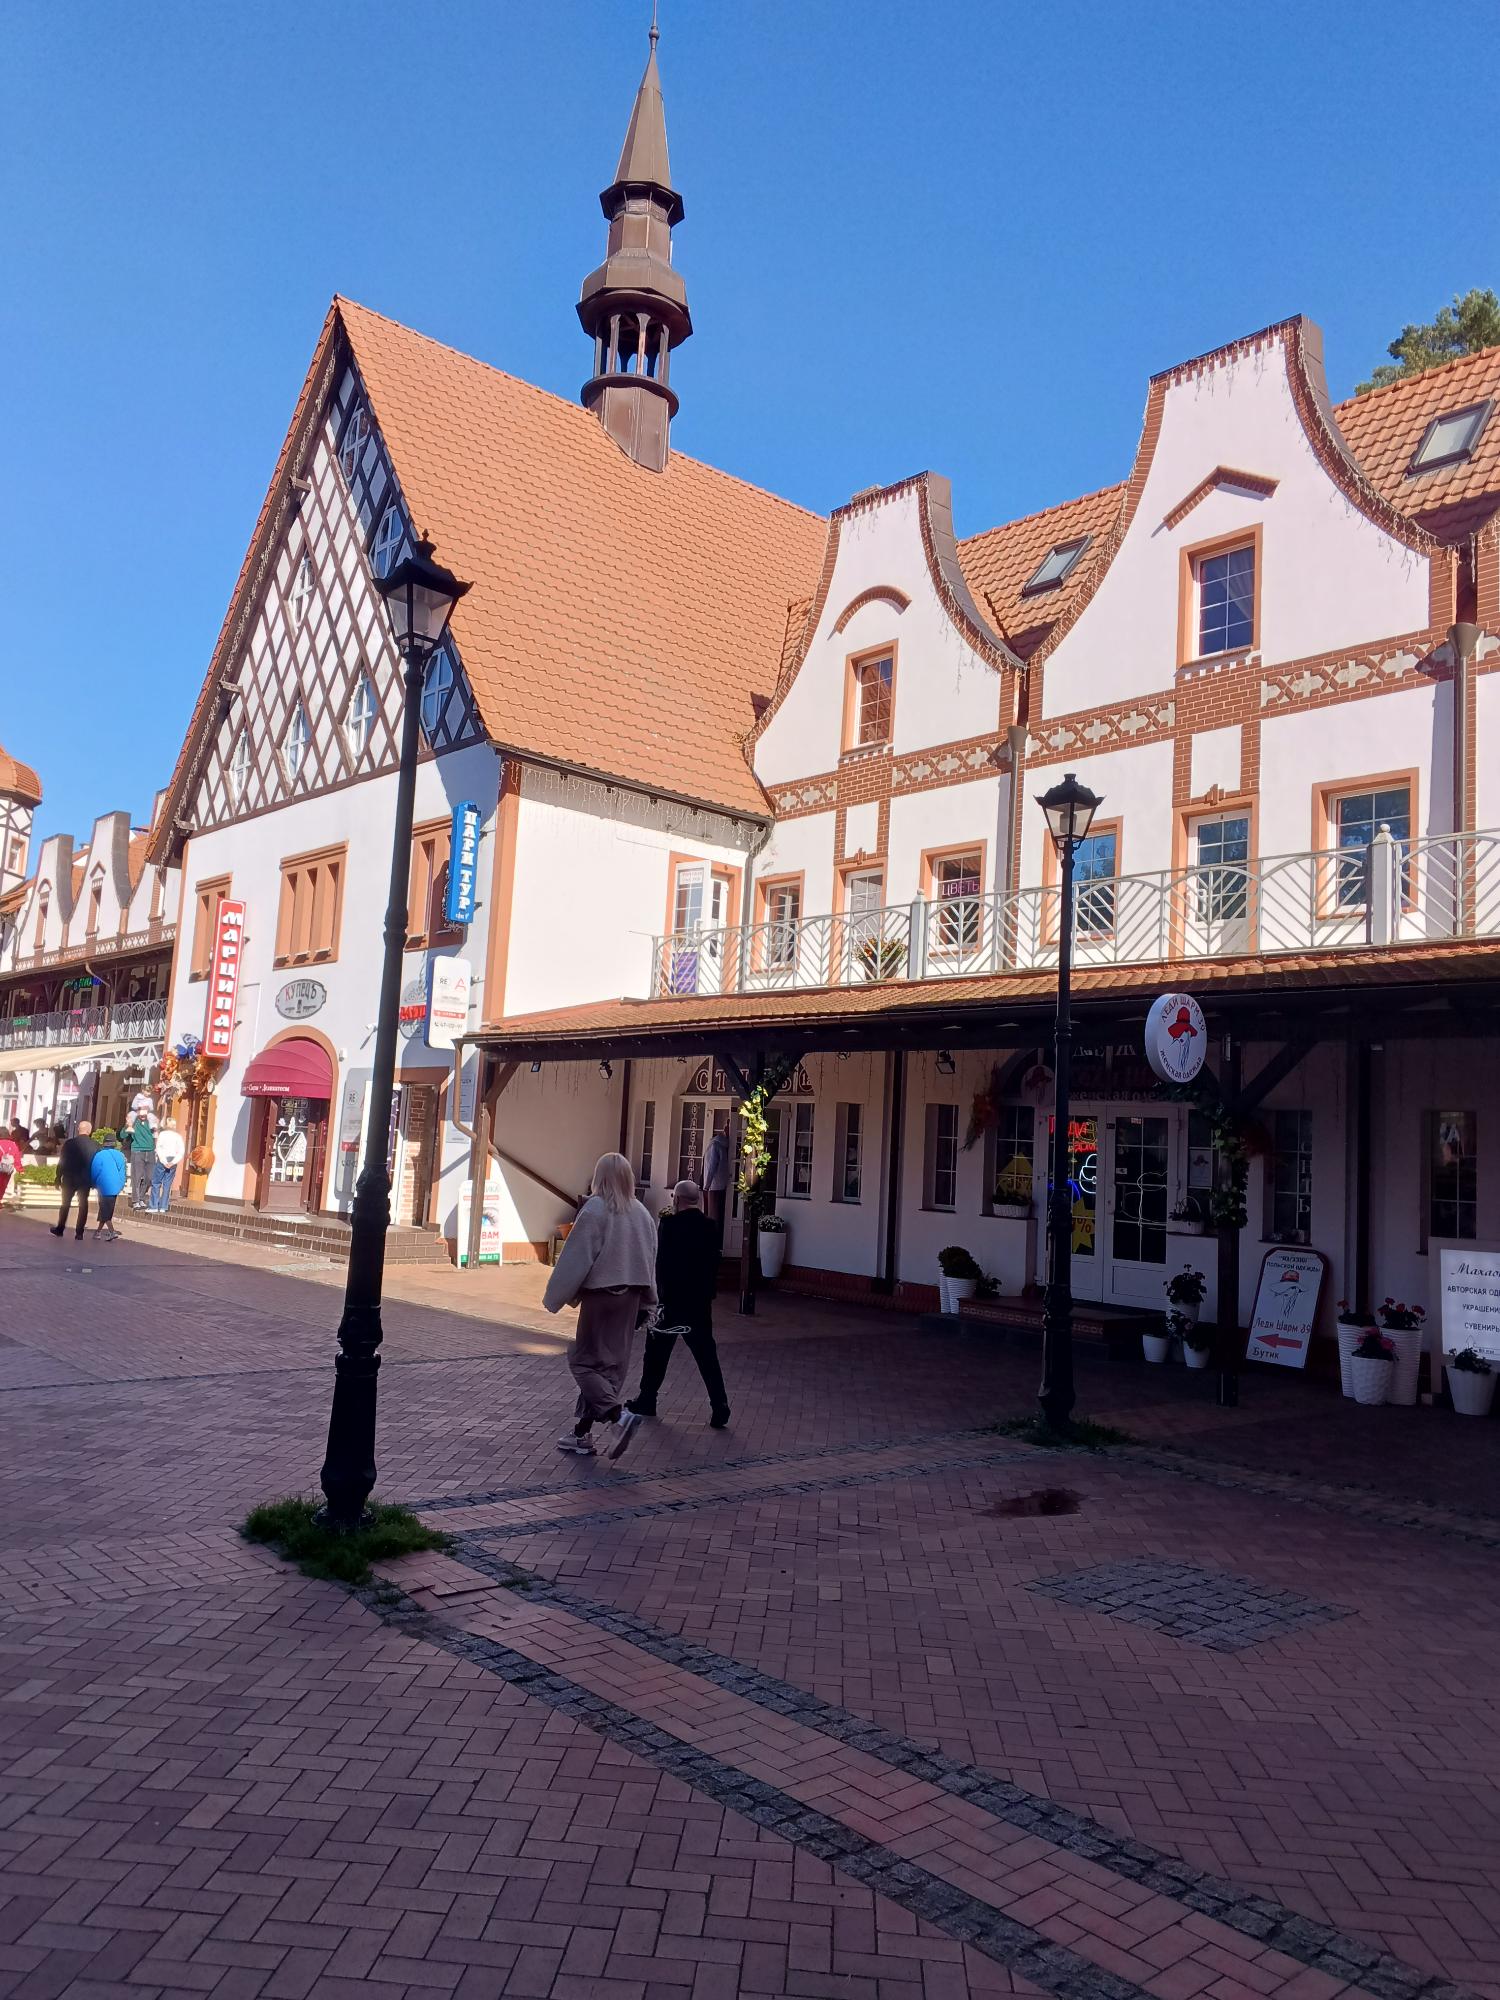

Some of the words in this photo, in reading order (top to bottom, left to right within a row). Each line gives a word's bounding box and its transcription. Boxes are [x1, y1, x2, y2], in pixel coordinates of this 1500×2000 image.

[460, 810, 478, 865] ПАРИ
[458, 869, 473, 910] ТУР
[213, 911, 244, 1047] МАРЦИПАН
[1450, 1263, 1500, 1277] Махао
[1447, 1284, 1487, 1295] АВТОРСКАЯ
[1462, 1303, 1500, 1314] УКРАШЕНИ
[1252, 1346, 1280, 1360] Бутик
